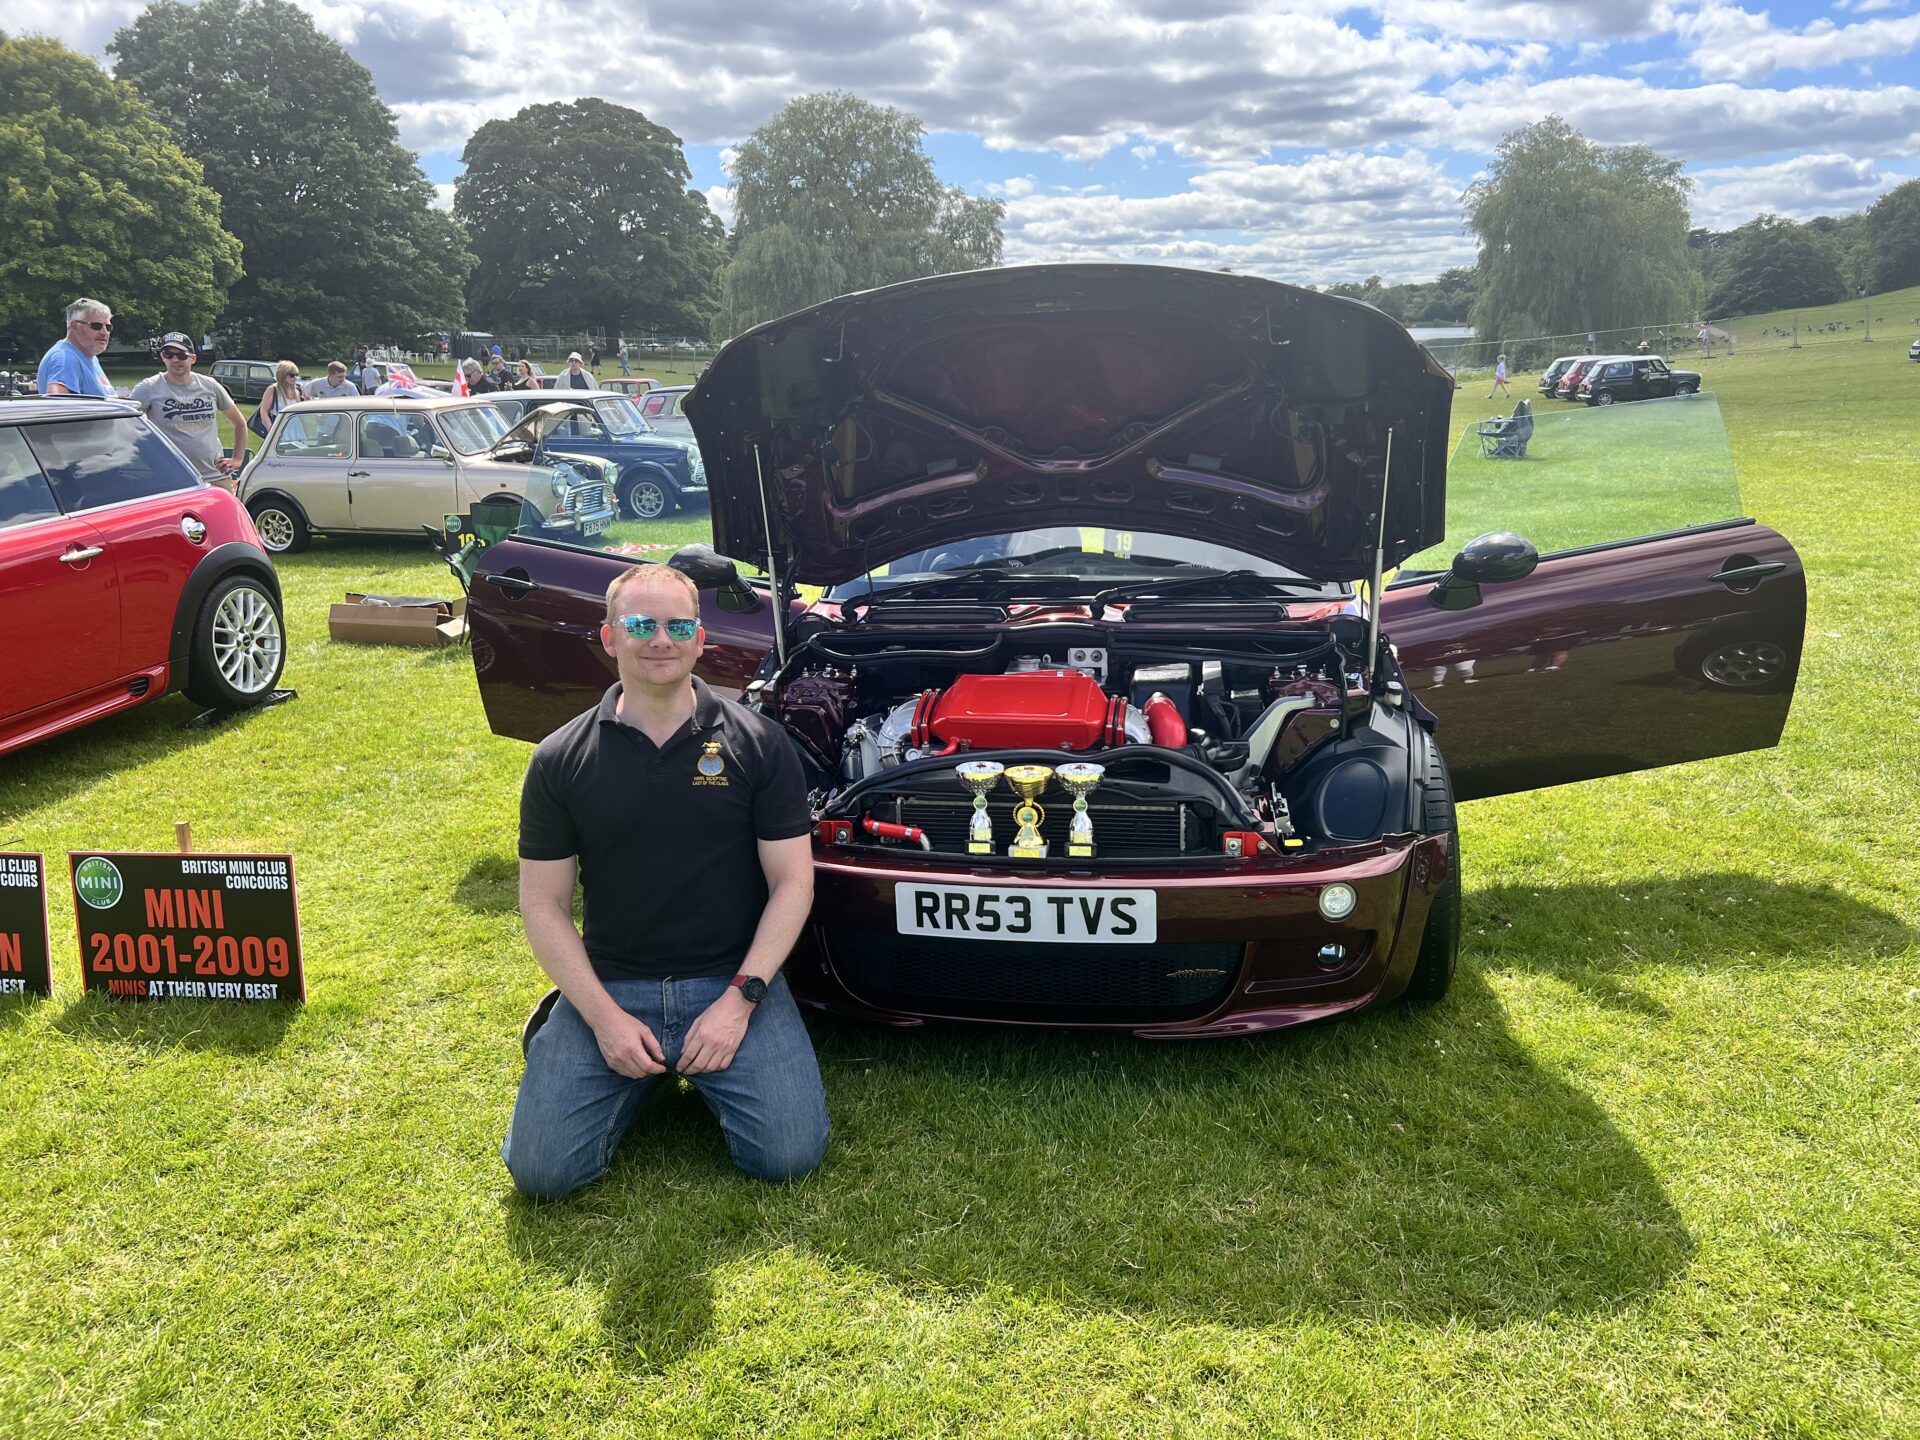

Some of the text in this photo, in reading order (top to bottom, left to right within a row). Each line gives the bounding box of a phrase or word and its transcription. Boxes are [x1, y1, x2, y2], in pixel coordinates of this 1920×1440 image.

[1115, 532, 1132, 551] 19
[9, 859, 37, 873] CLUB
[82, 860, 112, 872] BRITISH
[181, 860, 287, 875] BRITISH MINI CLUB
[80, 876, 118, 889] MINI
[225, 875, 289, 890] CONCOURS
[91, 898, 111, 906] CLUB
[144, 888, 225, 929] MINI
[914, 890, 1137, 936] RR53 TVS
[90, 932, 290, 977] 2001-2009
[108, 979, 279, 1000] MINIS AT THEIR VERY BEST
